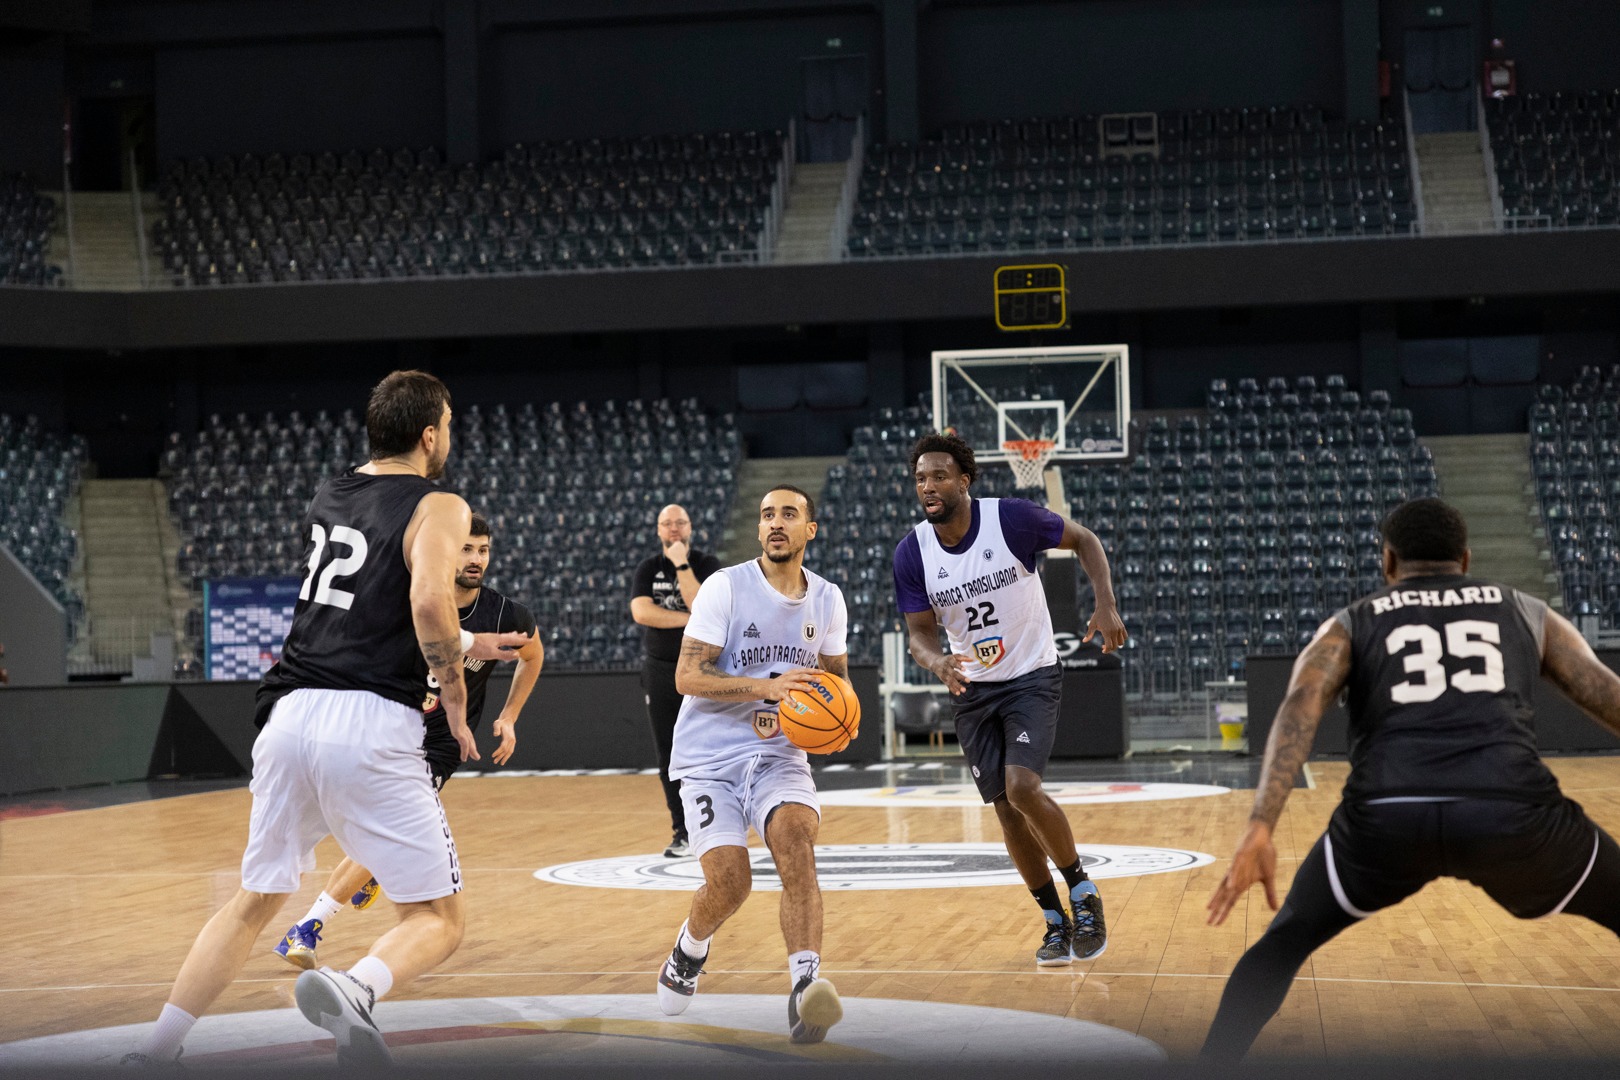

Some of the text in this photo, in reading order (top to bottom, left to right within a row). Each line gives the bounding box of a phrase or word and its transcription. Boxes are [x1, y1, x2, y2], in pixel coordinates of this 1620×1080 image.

[929, 566, 1019, 608] U-BANCA TRANSILVANIA
[1371, 586, 1503, 615] RICHARD
[965, 601, 999, 632] 22
[743, 630, 761, 638] PEAK
[806, 627, 814, 638] U
[731, 645, 771, 669] U-BANCA
[979, 644, 998, 657] BT
[1386, 620, 1506, 704] 35
[758, 716, 776, 728] BT
[696, 794, 715, 829] 3
